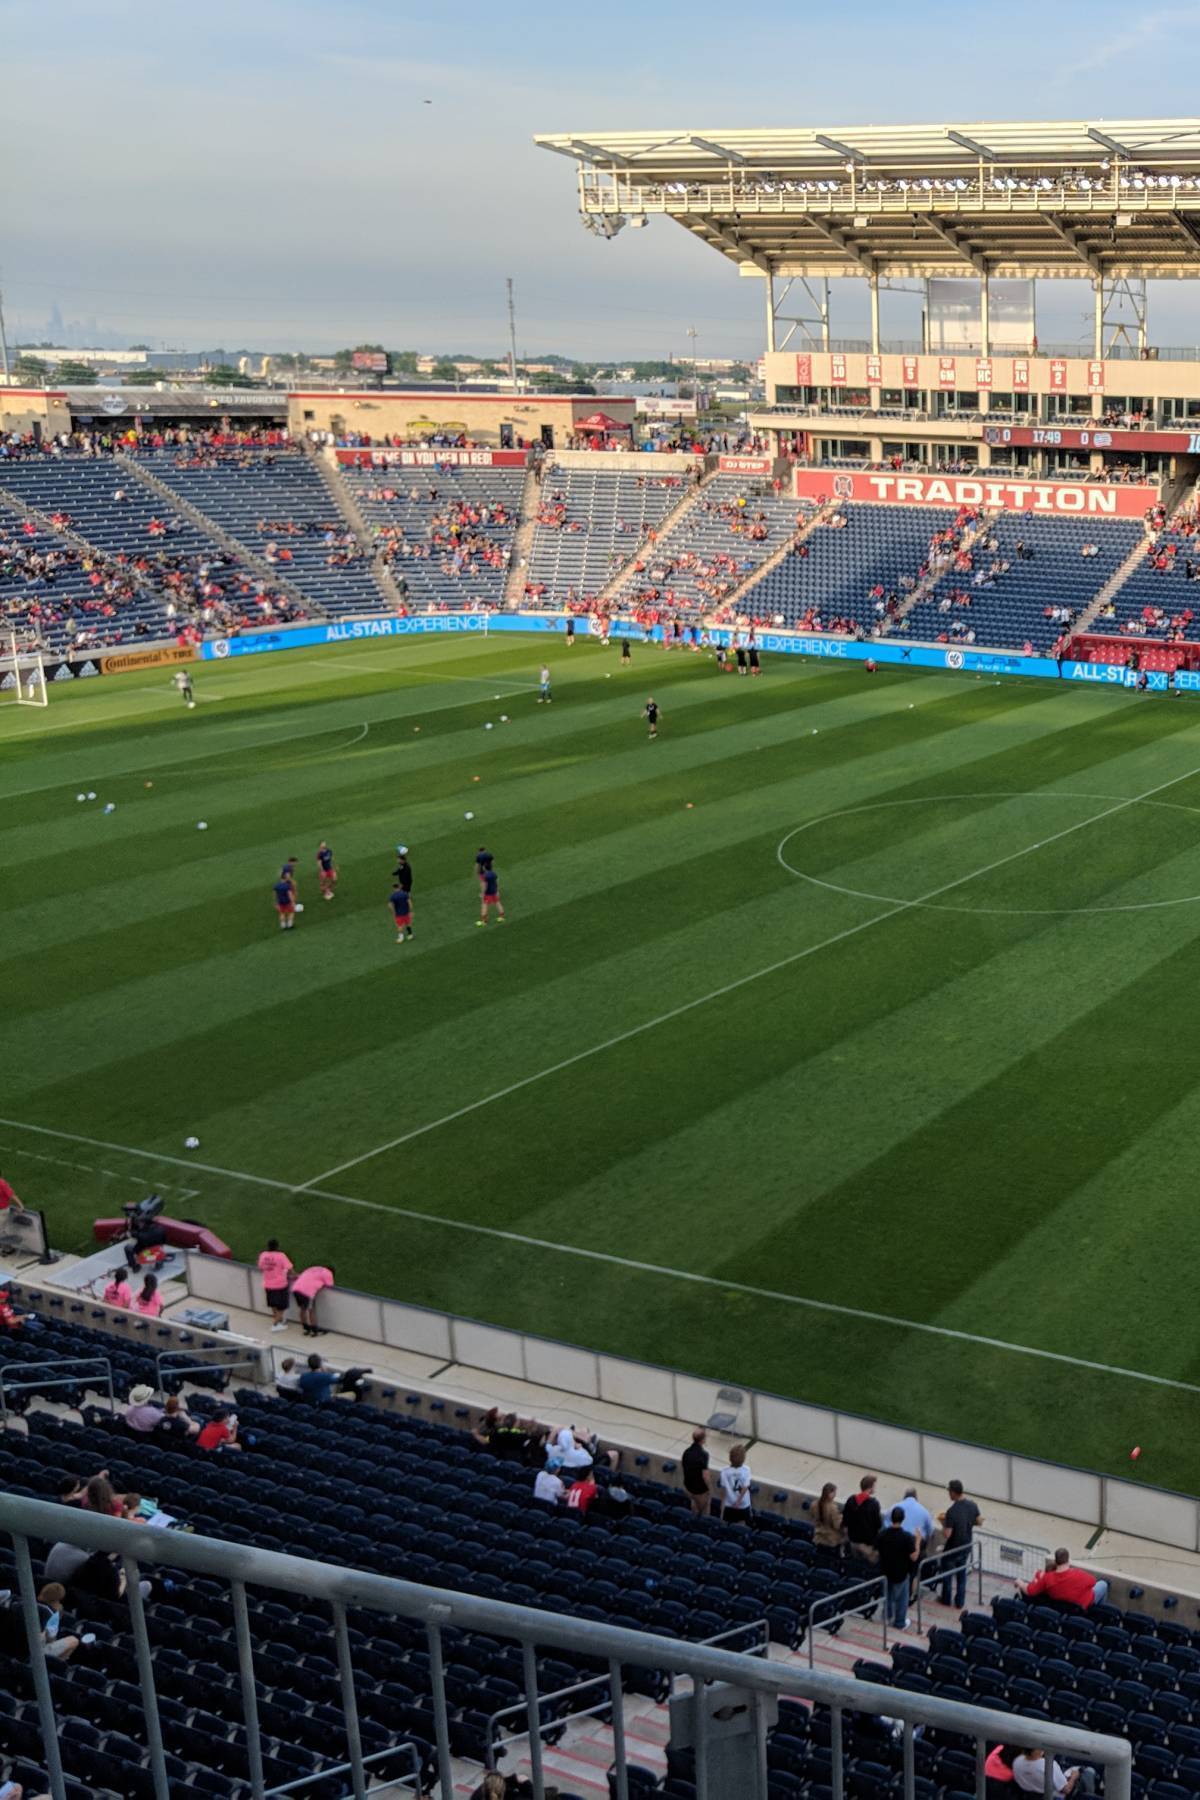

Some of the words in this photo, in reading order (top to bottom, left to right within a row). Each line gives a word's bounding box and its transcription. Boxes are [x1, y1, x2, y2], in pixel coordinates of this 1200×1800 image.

[833, 365, 845, 378] 10
[868, 367, 881, 379] 41
[906, 367, 914, 380] 5
[977, 370, 991, 382] HC
[1014, 370, 1028, 383] 14
[1054, 372, 1063, 384] 2
[1092, 373, 1100, 385] 9
[1002, 429, 1011, 442] 0
[1033, 430, 1062, 444] 17:49
[1080, 432, 1089, 445] 0
[416, 451, 435, 465] YOU
[870, 477, 1116, 512] TRADITION
[326, 620, 392, 640] ALL-STAR
[395, 614, 488, 632] EXPERIENCE
[767, 636, 847, 657] EXPERIENCE
[105, 647, 162, 671] Continental
[1072, 664, 1137, 687] ALL-STR
[568, 1488, 582, 1507] 11
